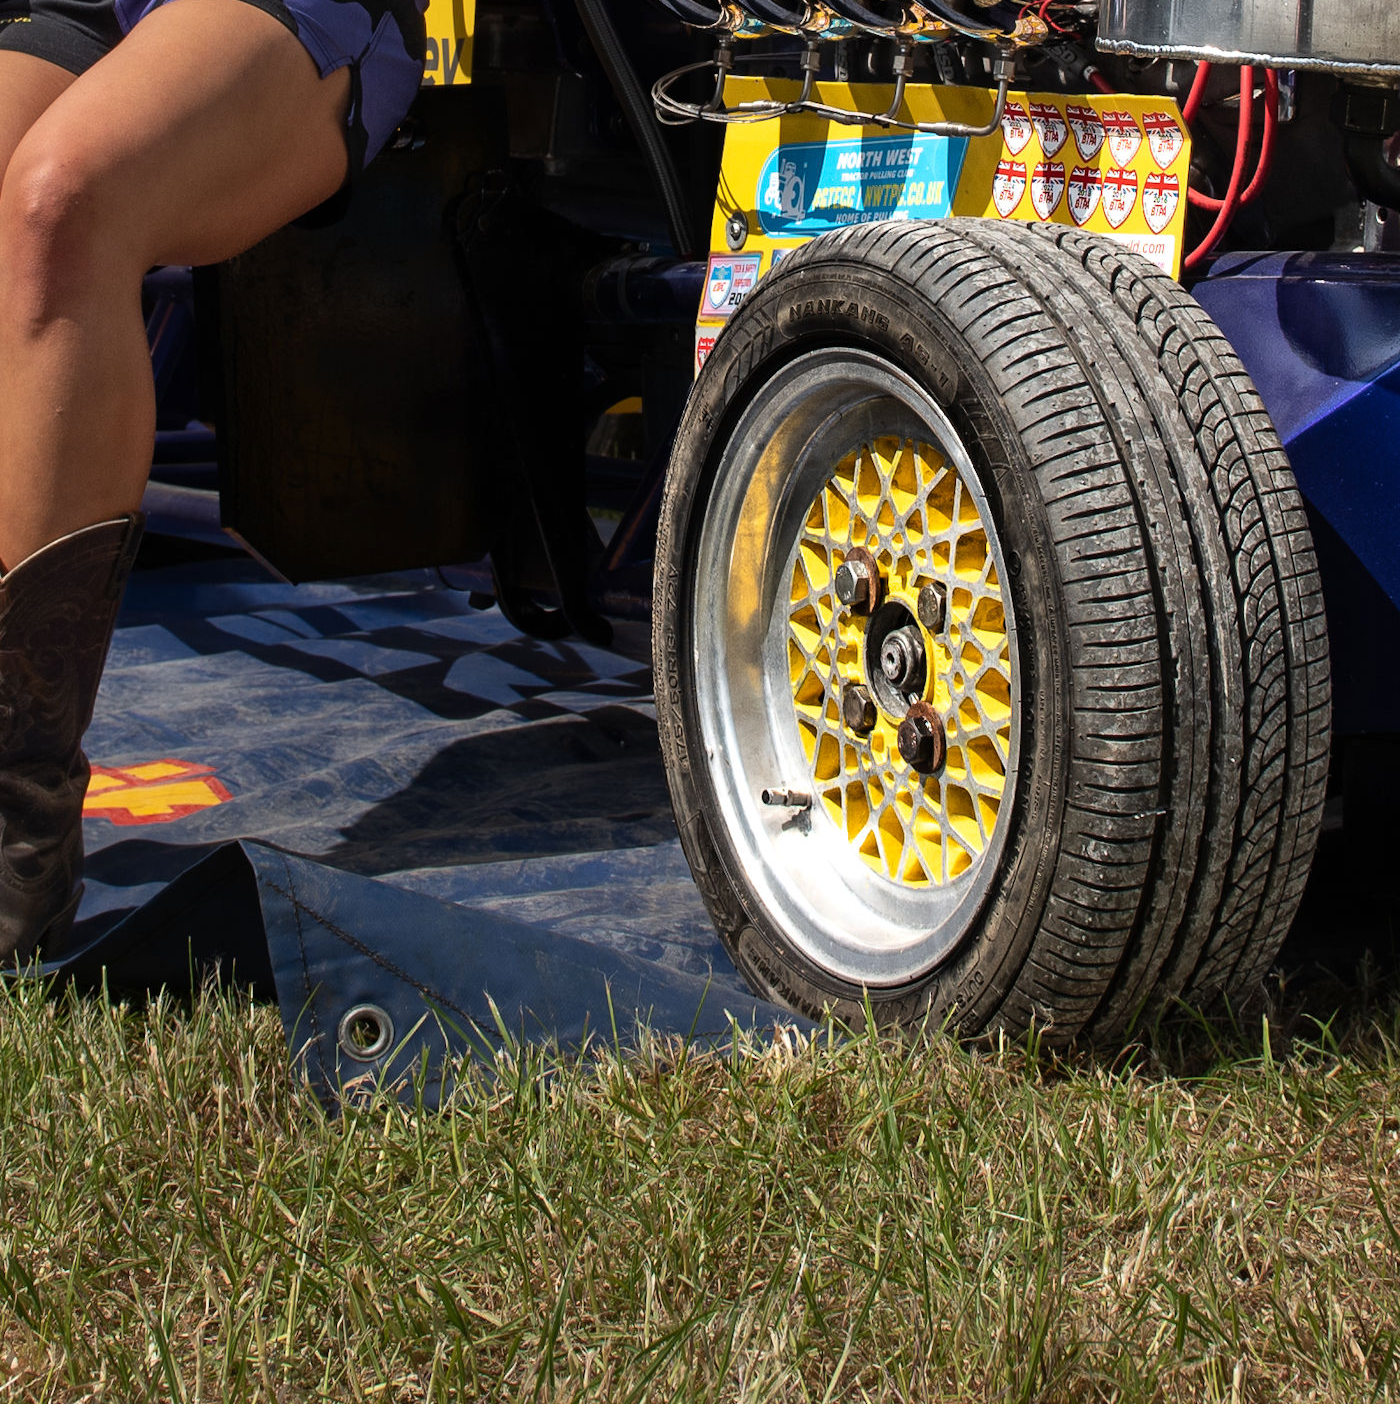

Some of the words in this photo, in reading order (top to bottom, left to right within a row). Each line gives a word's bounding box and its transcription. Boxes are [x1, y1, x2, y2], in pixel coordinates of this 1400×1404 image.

[836, 150, 883, 169] NORTH
[886, 147, 924, 165] WEST
[841, 172, 869, 182] TRACTOR
[869, 170, 897, 179] PULLING
[897, 169, 915, 178] CLUB
[865, 181, 945, 207] NWTPC.CO.UK
[836, 213, 860, 224] HOME
[862, 212, 872, 223] OF
[789, 298, 891, 332] NANKANG
